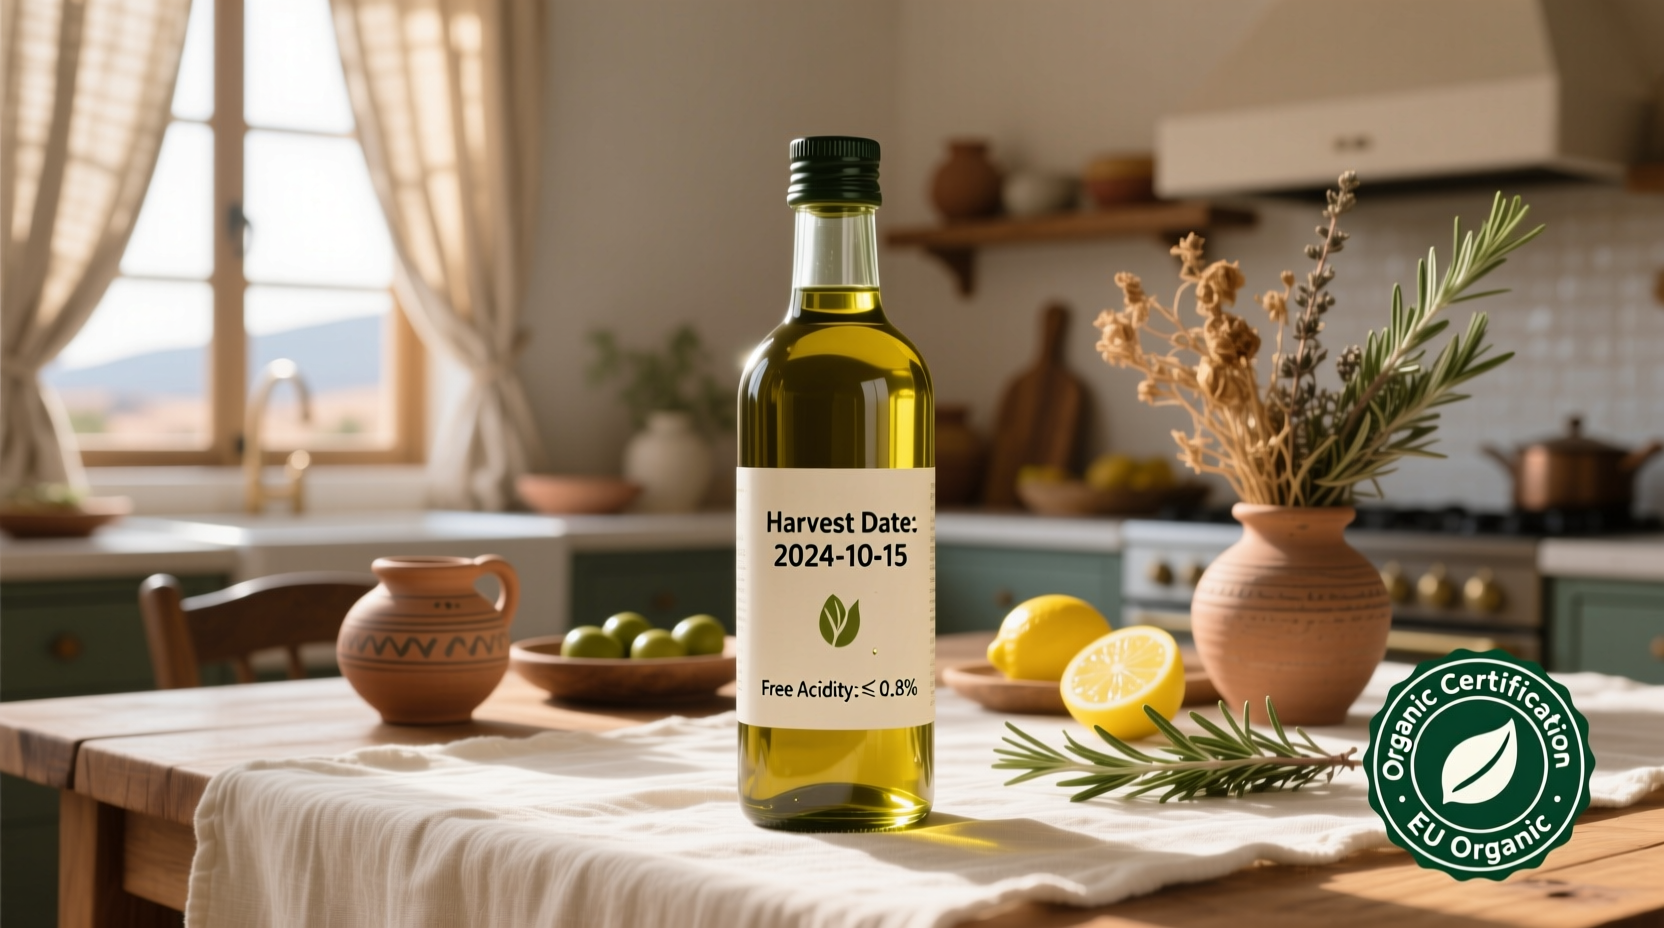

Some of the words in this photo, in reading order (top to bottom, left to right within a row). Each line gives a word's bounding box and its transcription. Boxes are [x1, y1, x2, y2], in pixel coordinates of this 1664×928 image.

[766, 511, 855, 534] Harvest
[861, 511, 918, 534] Date:
[773, 543, 908, 568] 2024-10-15
[761, 679, 794, 698] Free
[796, 680, 859, 703] Acidity:
[879, 678, 918, 698] 0.8%
